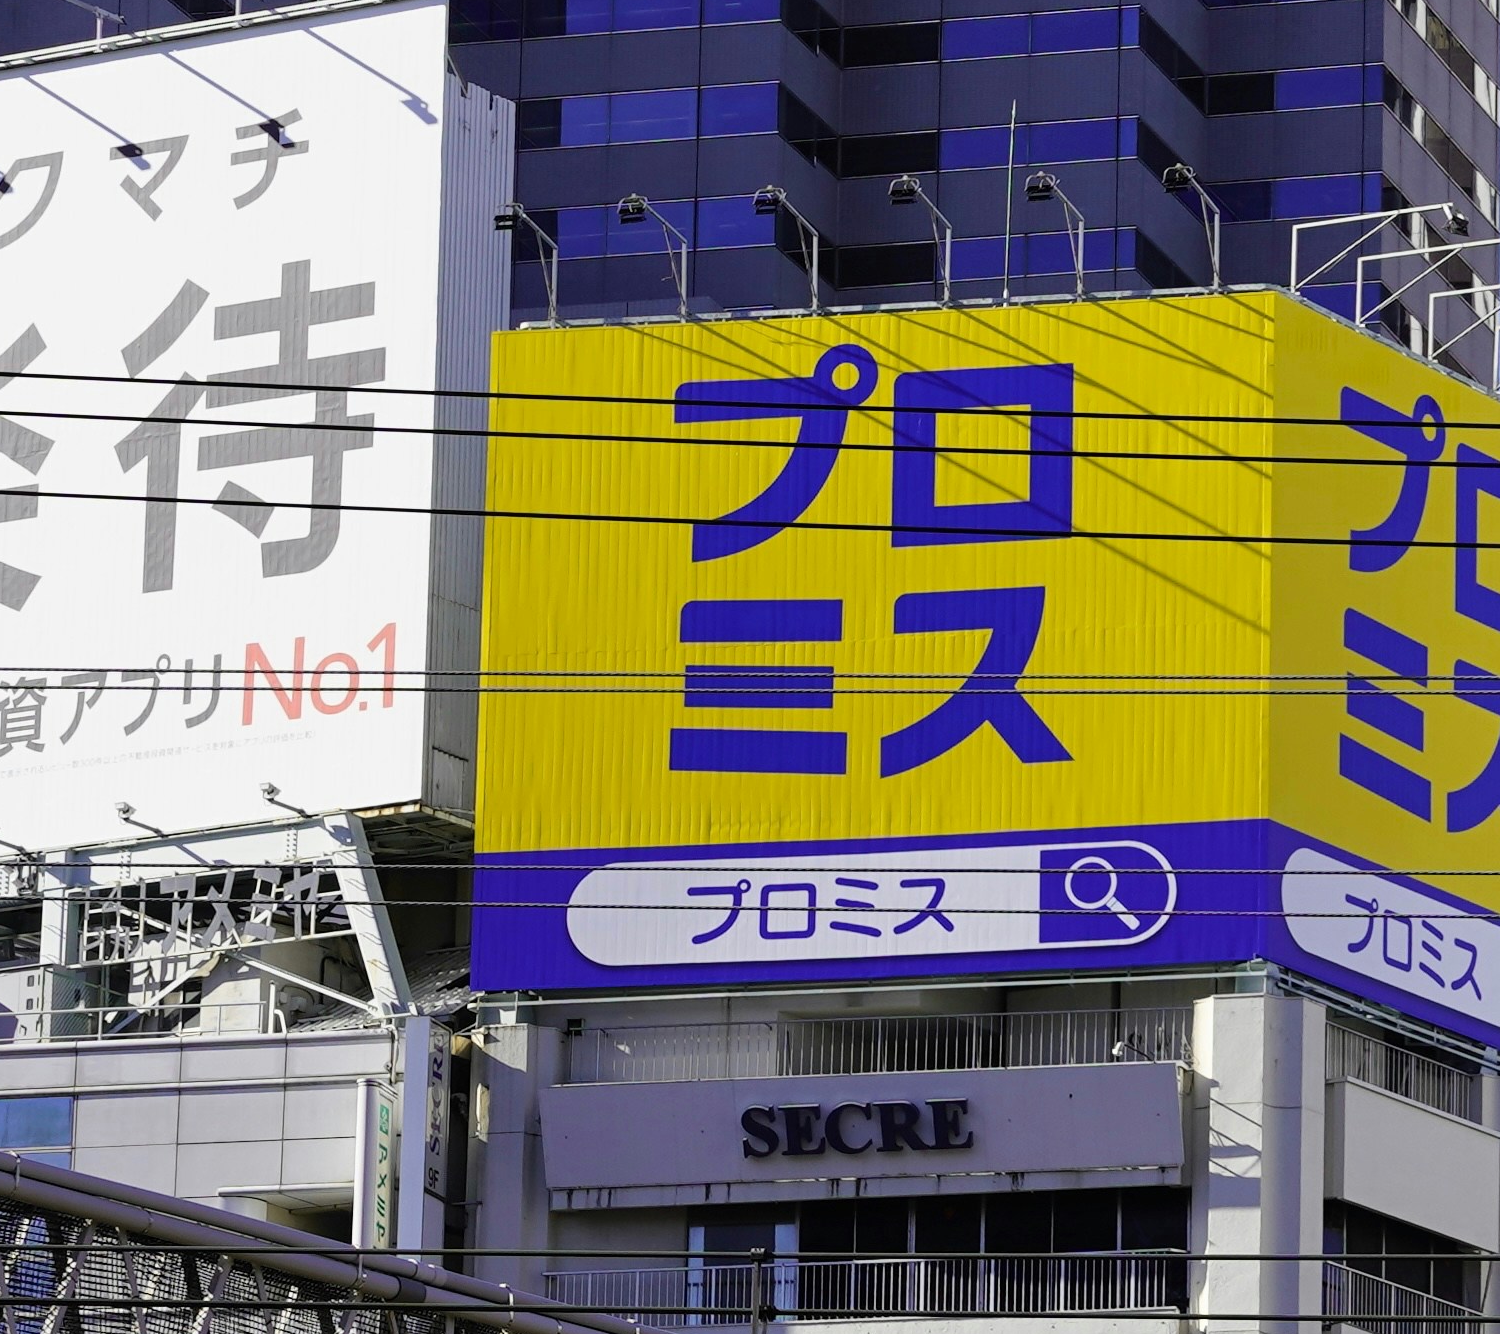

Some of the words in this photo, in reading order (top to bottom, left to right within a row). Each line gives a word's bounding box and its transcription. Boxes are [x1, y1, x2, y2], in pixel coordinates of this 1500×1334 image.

[673, 344, 1074, 564] プロ
[669, 586, 1074, 778] ミス
[686, 876, 956, 945] プロミス
[1343, 892, 1484, 1001] プロミス
[741, 1097, 975, 1158] SECRE
[428, 1167, 441, 1189] 9F
